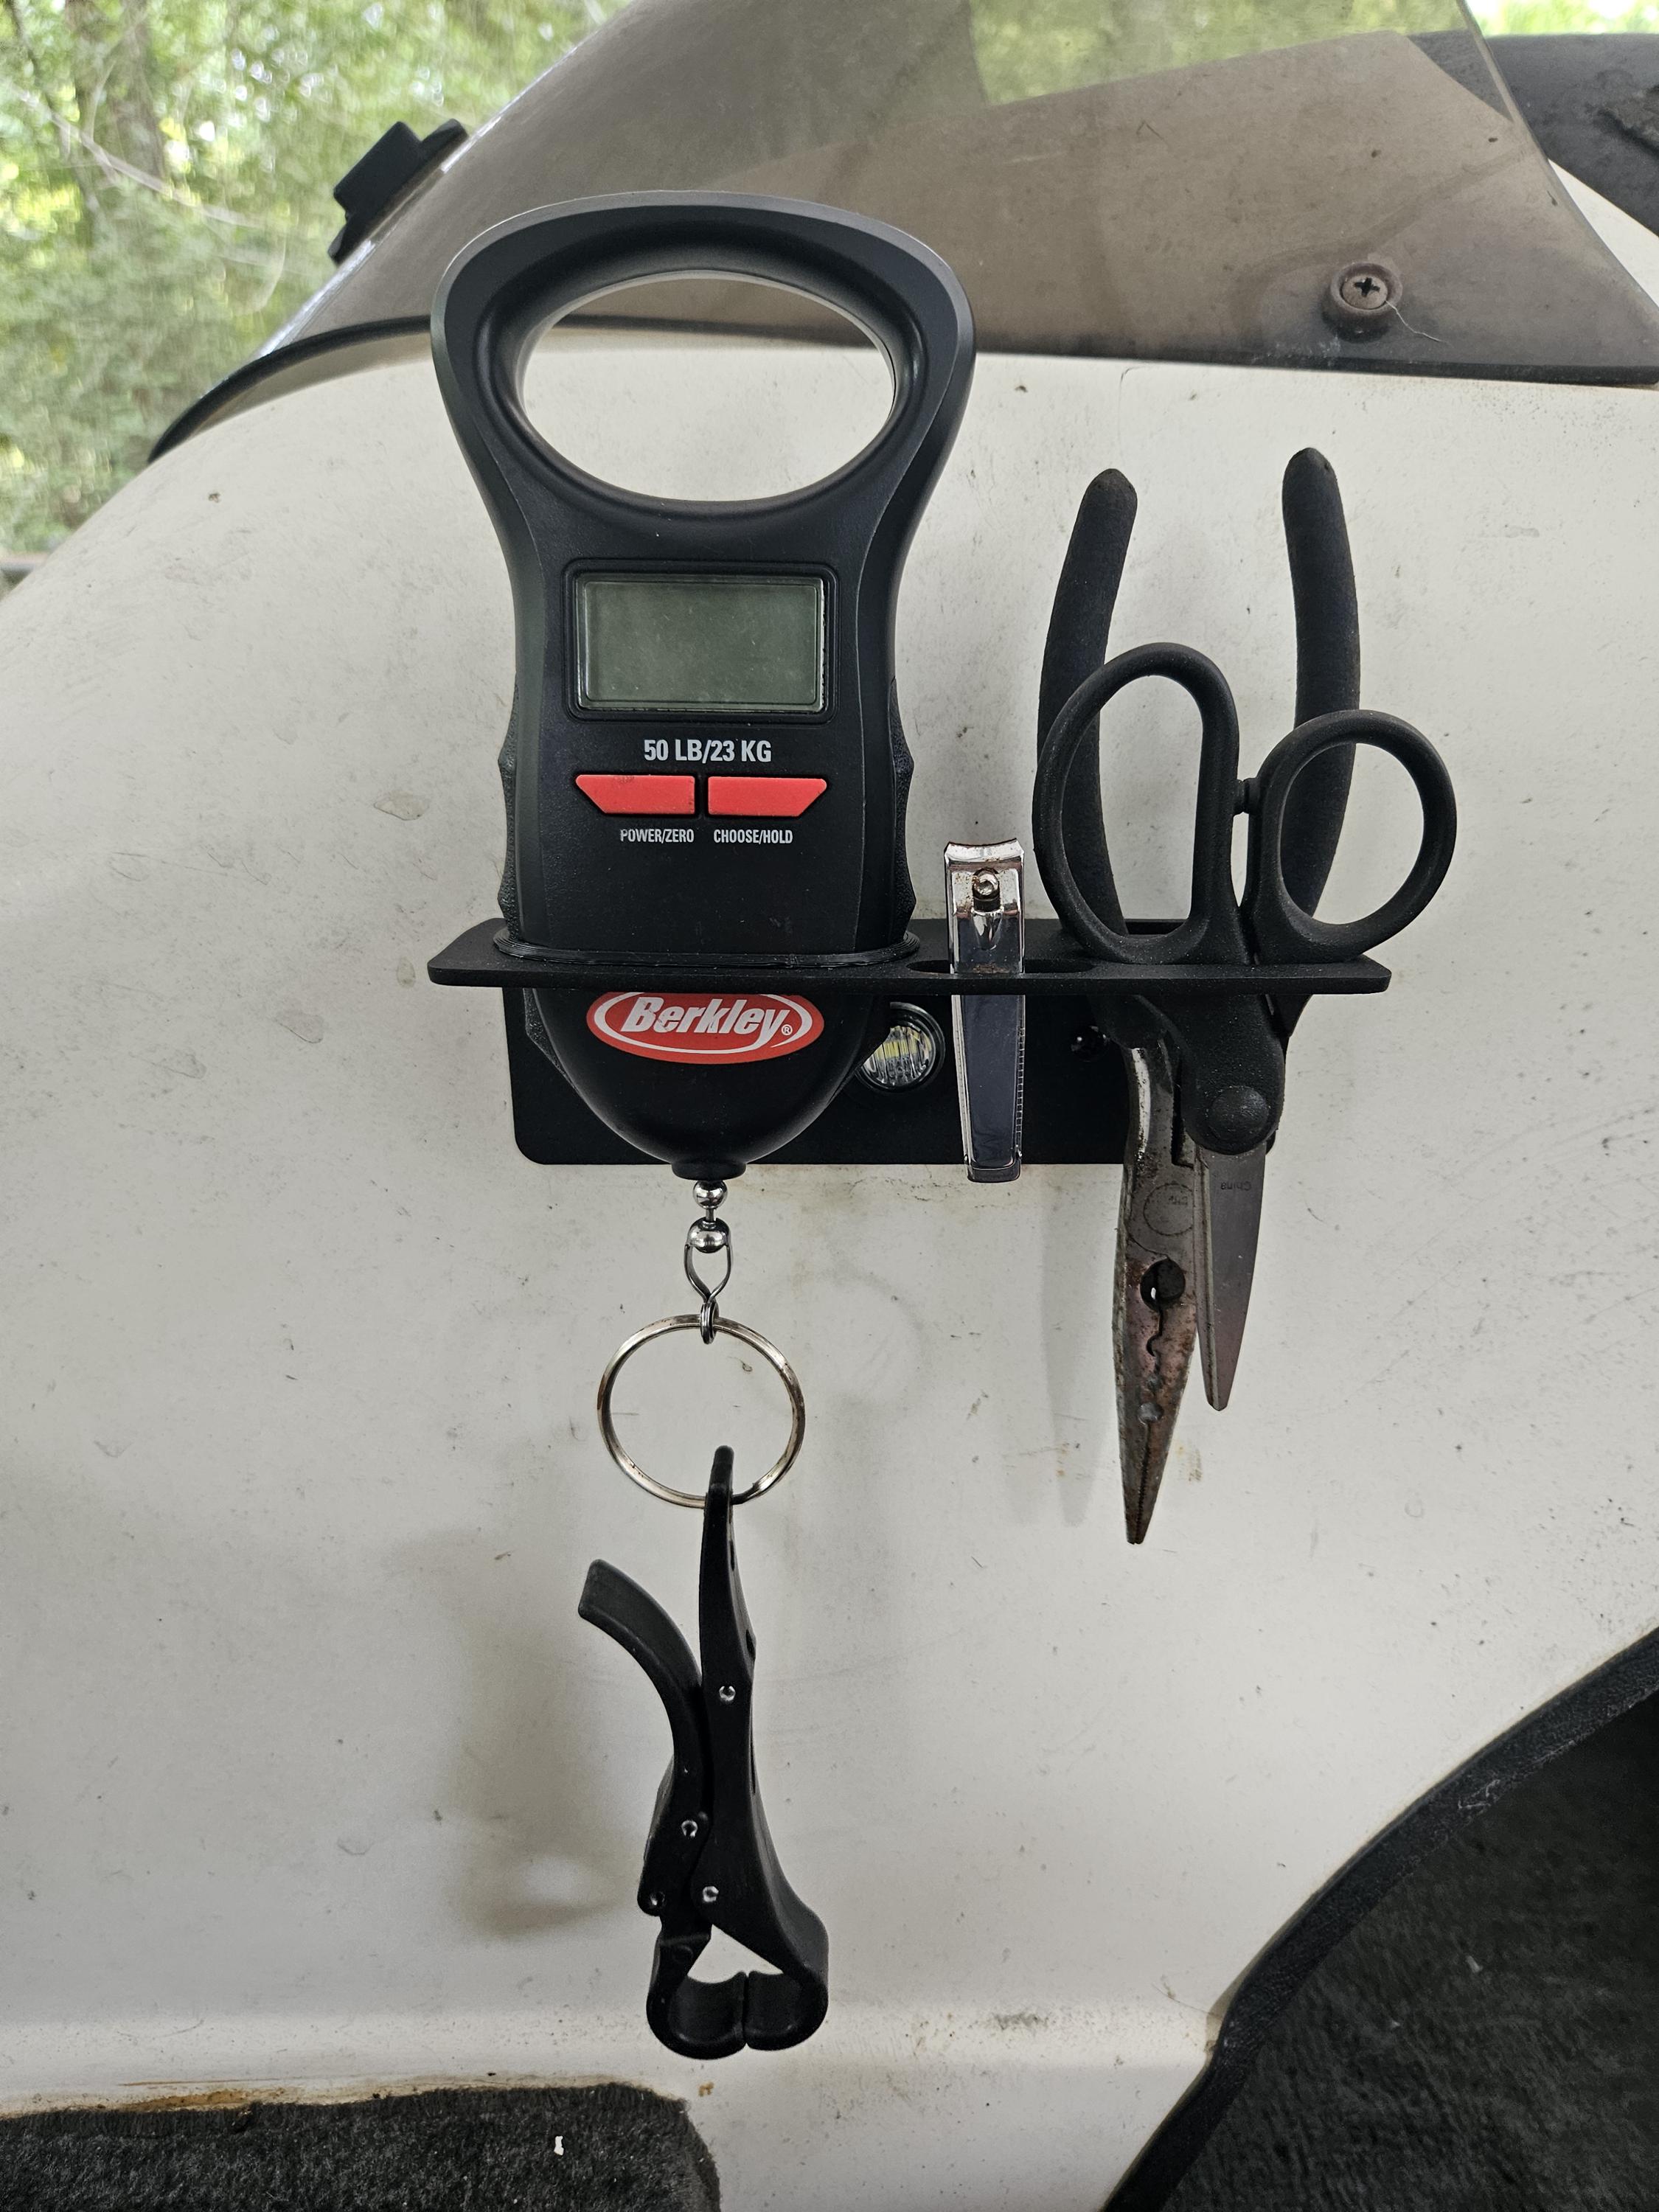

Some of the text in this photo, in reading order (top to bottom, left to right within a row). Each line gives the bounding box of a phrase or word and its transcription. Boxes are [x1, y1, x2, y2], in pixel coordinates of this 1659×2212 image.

[643, 739, 772, 765] 50 LB/23 KG
[619, 828, 695, 844] POWER/ZERO
[713, 828, 793, 845] CHOOSE/HOLD
